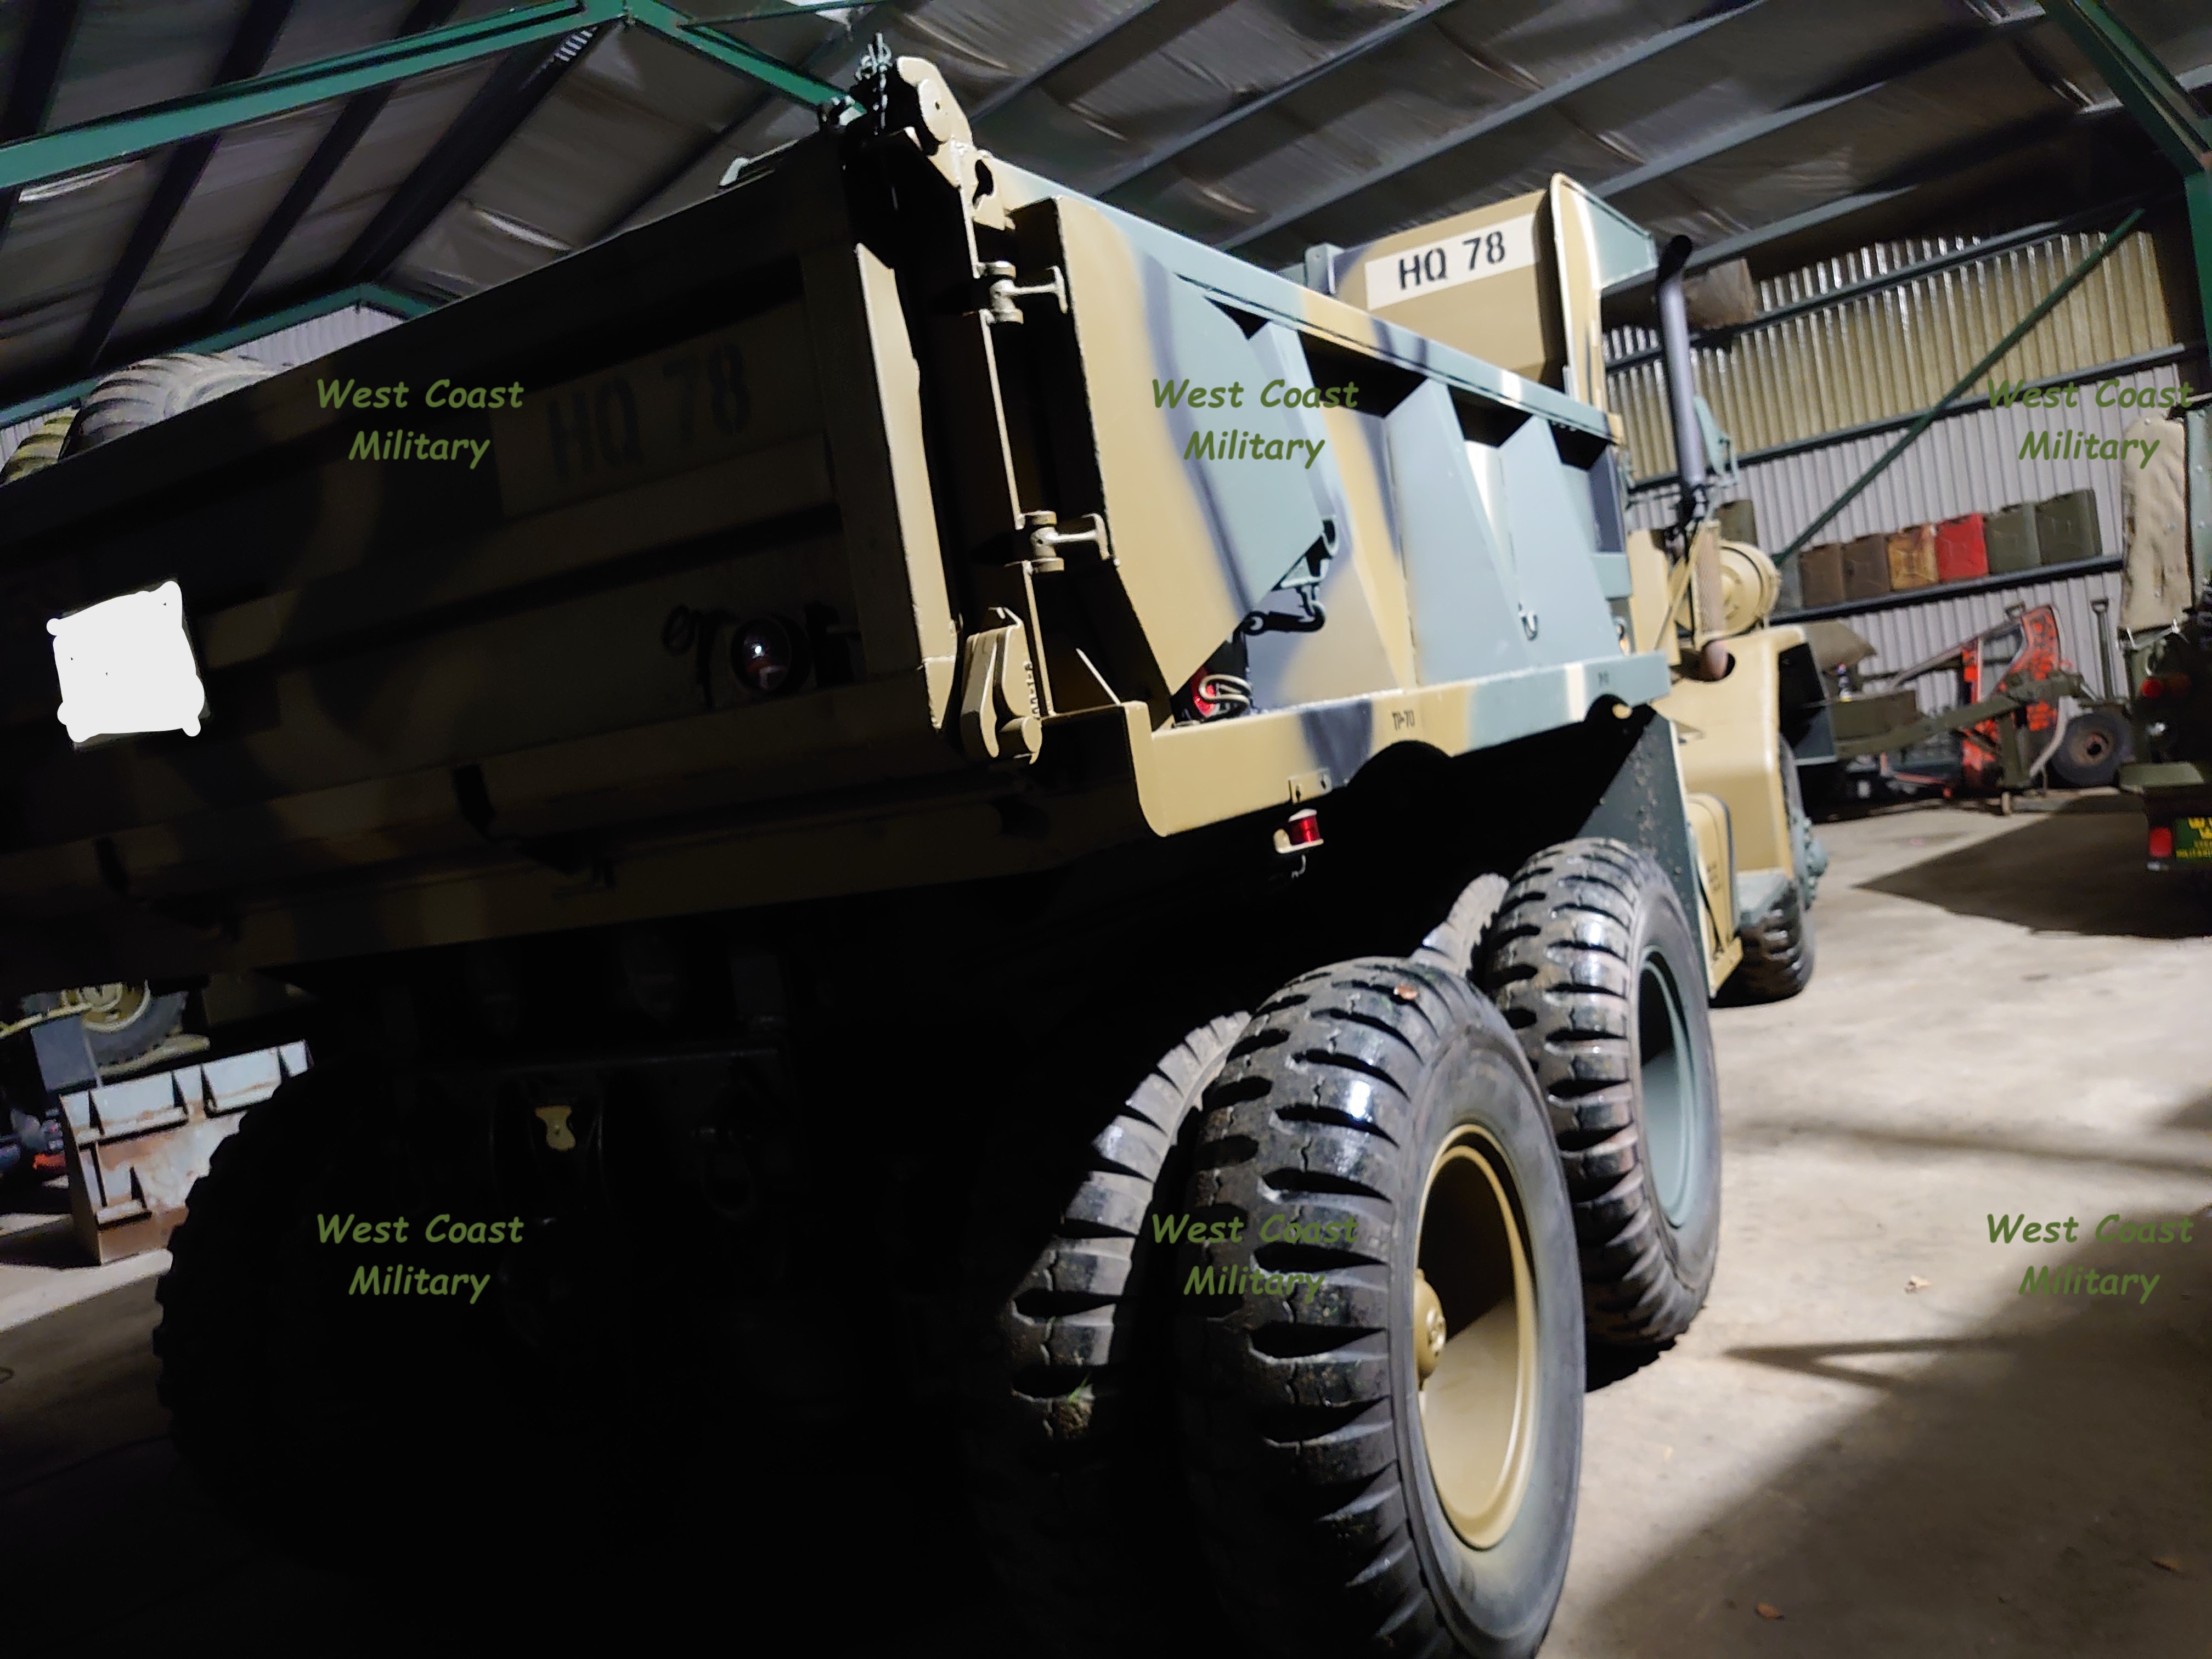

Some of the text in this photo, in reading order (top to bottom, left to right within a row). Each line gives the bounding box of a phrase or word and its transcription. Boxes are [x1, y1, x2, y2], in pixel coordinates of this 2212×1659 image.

[1399, 230, 1506, 290] HQ 78
[548, 342, 750, 476] HQ 78
